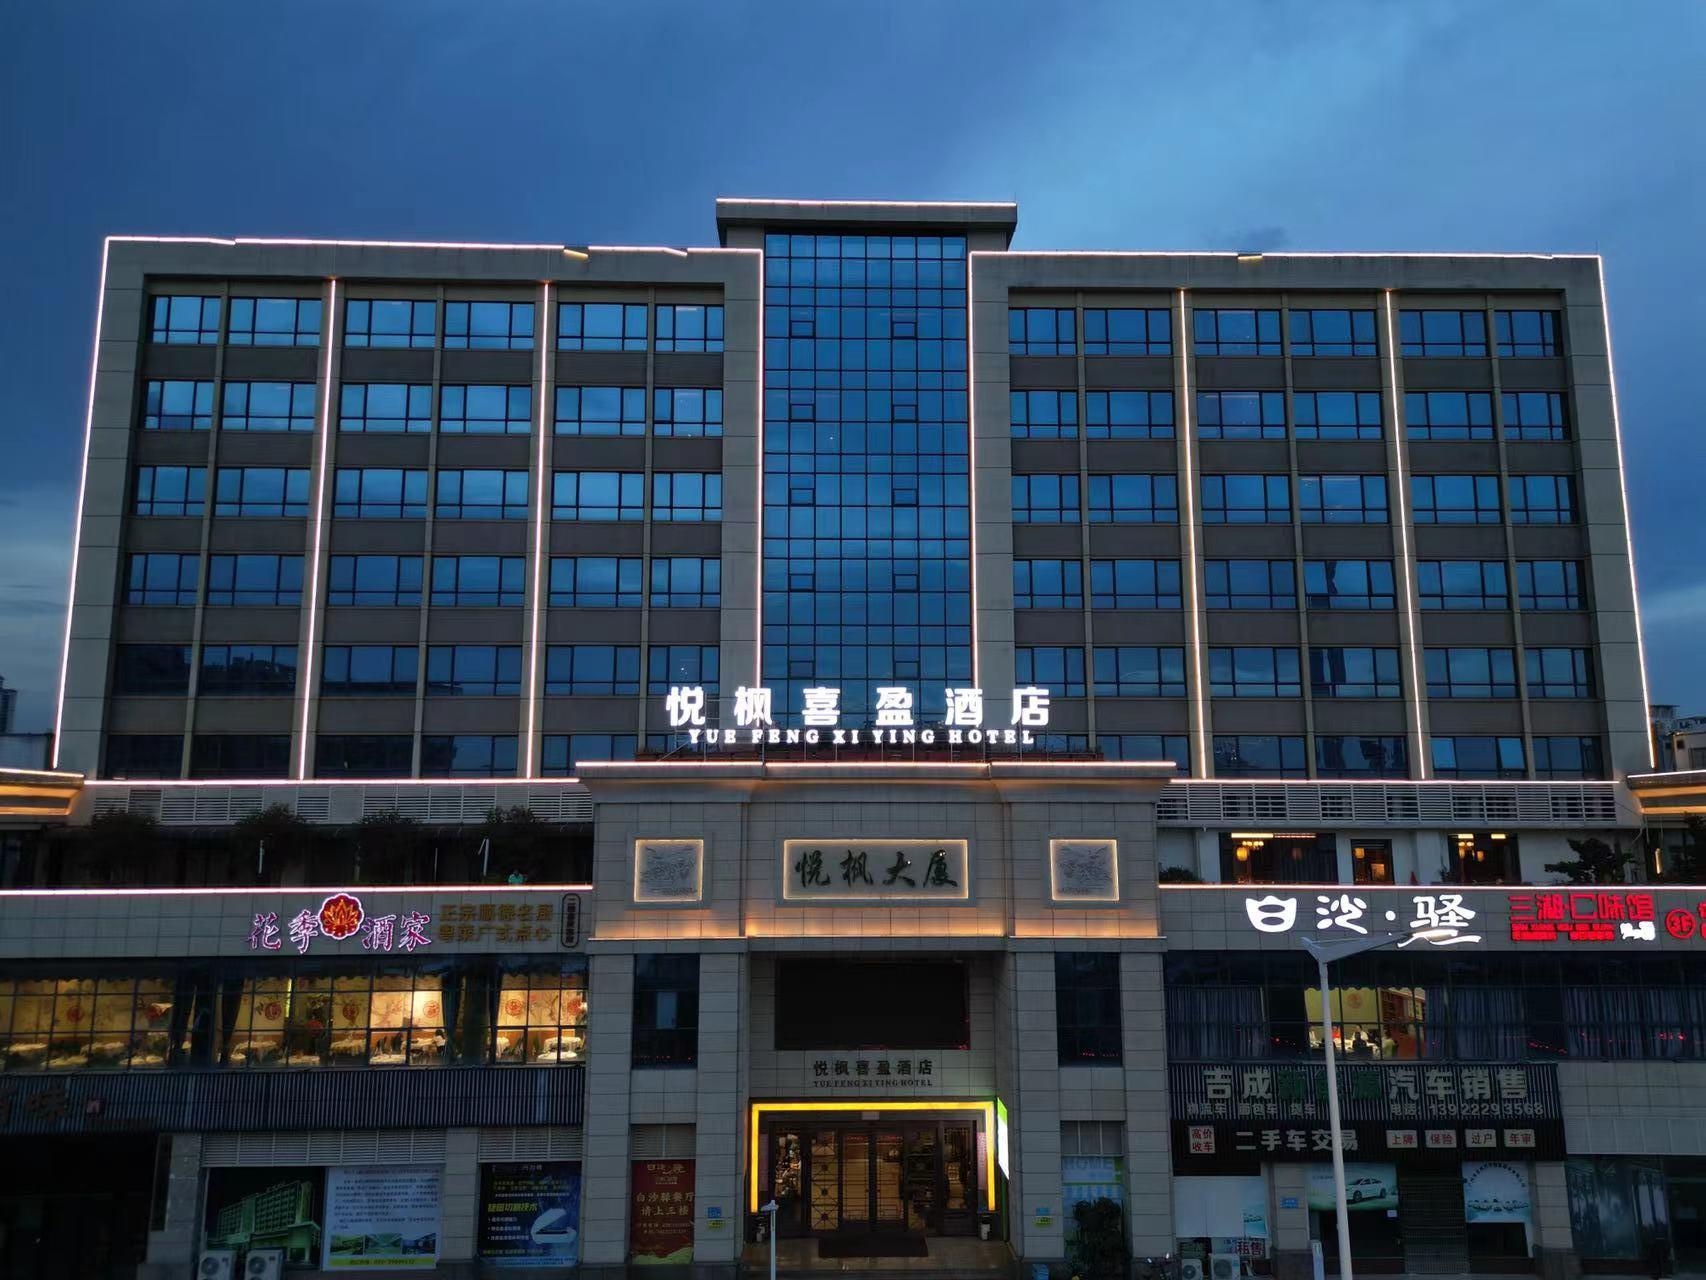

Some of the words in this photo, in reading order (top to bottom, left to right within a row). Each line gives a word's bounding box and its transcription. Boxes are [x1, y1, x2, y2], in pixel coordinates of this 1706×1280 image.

[665, 686, 1051, 728] 悦枫喜盈酒店
[689, 729, 737, 745] YUE
[752, 729, 821, 745] FENG
[834, 729, 860, 745] XI
[873, 729, 936, 745] YING
[949, 729, 1035, 745] HOTEL
[795, 850, 958, 888] 悦枫大厦
[246, 909, 432, 954] 花季酒家
[814, 1059, 933, 1077] 悦枫喜盈酒店
[1192, 1129, 1214, 1140] 高价
[1235, 1128, 1359, 1152] 二手车交易
[1391, 1134, 1413, 1145] 上牌
[1430, 1134, 1453, 1145] 保险
[1471, 1133, 1493, 1145] 过户
[1508, 1133, 1531, 1145] 年审
[1192, 1141, 1214, 1152] 收车
